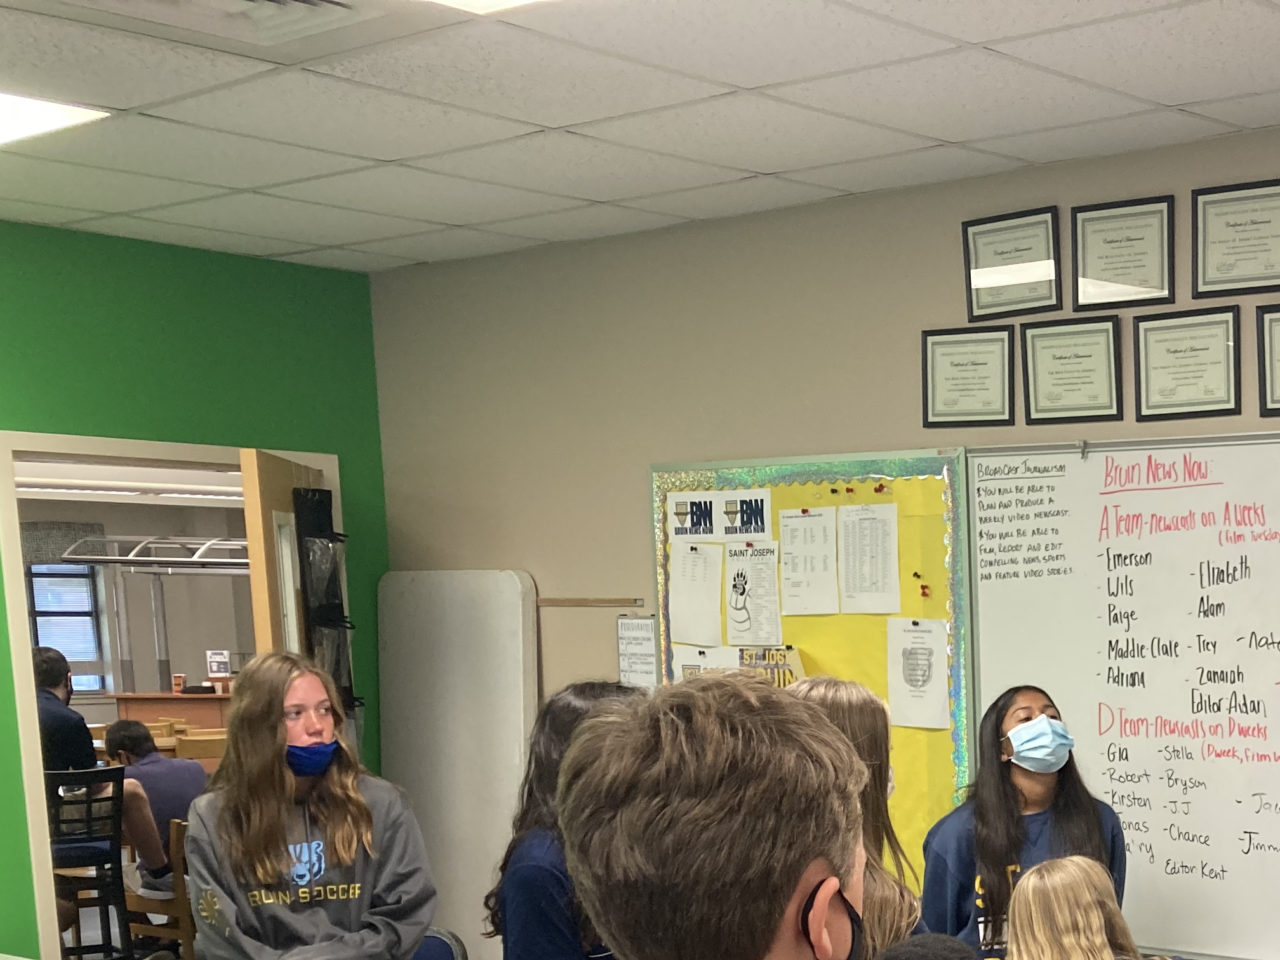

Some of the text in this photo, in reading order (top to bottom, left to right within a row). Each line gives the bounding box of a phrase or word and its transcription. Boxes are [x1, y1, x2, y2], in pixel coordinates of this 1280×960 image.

[1104, 454, 1178, 489] Bruin News
[1099, 501, 1232, 542] A on A
[729, 547, 775, 558] SAINT JOSEPH
[1106, 547, 1152, 572] Emerson
[1199, 555, 1251, 590] Elizabeth
[1107, 575, 1134, 598] Wils
[1108, 603, 1139, 632] Paige
[1198, 595, 1226, 619] Adam
[1196, 634, 1217, 655] Trey
[1098, 702, 1225, 738] D on
[1107, 742, 1129, 762] Gia
[1164, 744, 1195, 762] Stella
[1107, 767, 1152, 784] Robert
[1168, 823, 1212, 848] Chance
[1164, 858, 1231, 881] Editor Kent
